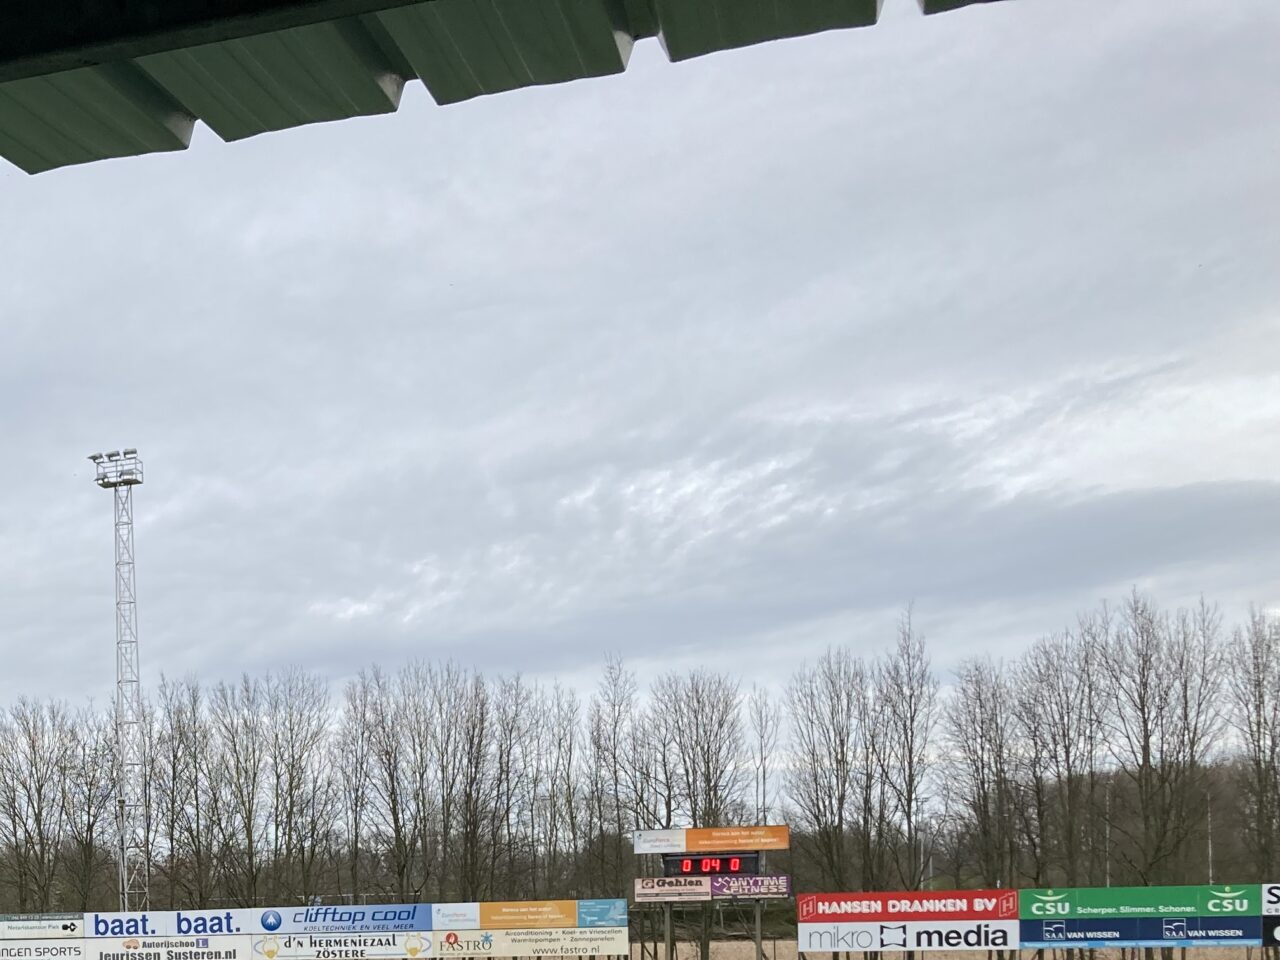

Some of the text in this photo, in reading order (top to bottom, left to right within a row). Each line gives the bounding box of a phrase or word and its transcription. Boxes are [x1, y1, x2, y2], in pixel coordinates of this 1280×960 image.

[682, 859, 692, 872] 0
[702, 858, 720, 872] 04
[730, 858, 740, 872] 0
[656, 878, 703, 888] Gehlen
[730, 876, 788, 886] ANYTIME
[730, 885, 787, 894] FITNESS
[818, 898, 997, 914] HANSEN DRANKEN BV
[1031, 902, 1070, 916] CSU
[1076, 904, 1197, 915] Scherper. Slimmer. Schoner.
[1208, 900, 1248, 912] CSU
[292, 905, 417, 925] clifftop cool
[94, 914, 156, 936] baat.
[176, 912, 241, 934] baat.
[809, 923, 1008, 949] mikro media
[1086, 931, 1120, 939] WISSEN
[35, 946, 82, 957] SPORTS
[440, 940, 492, 952] FASTRO
[315, 948, 366, 960] ZÖSTERE
